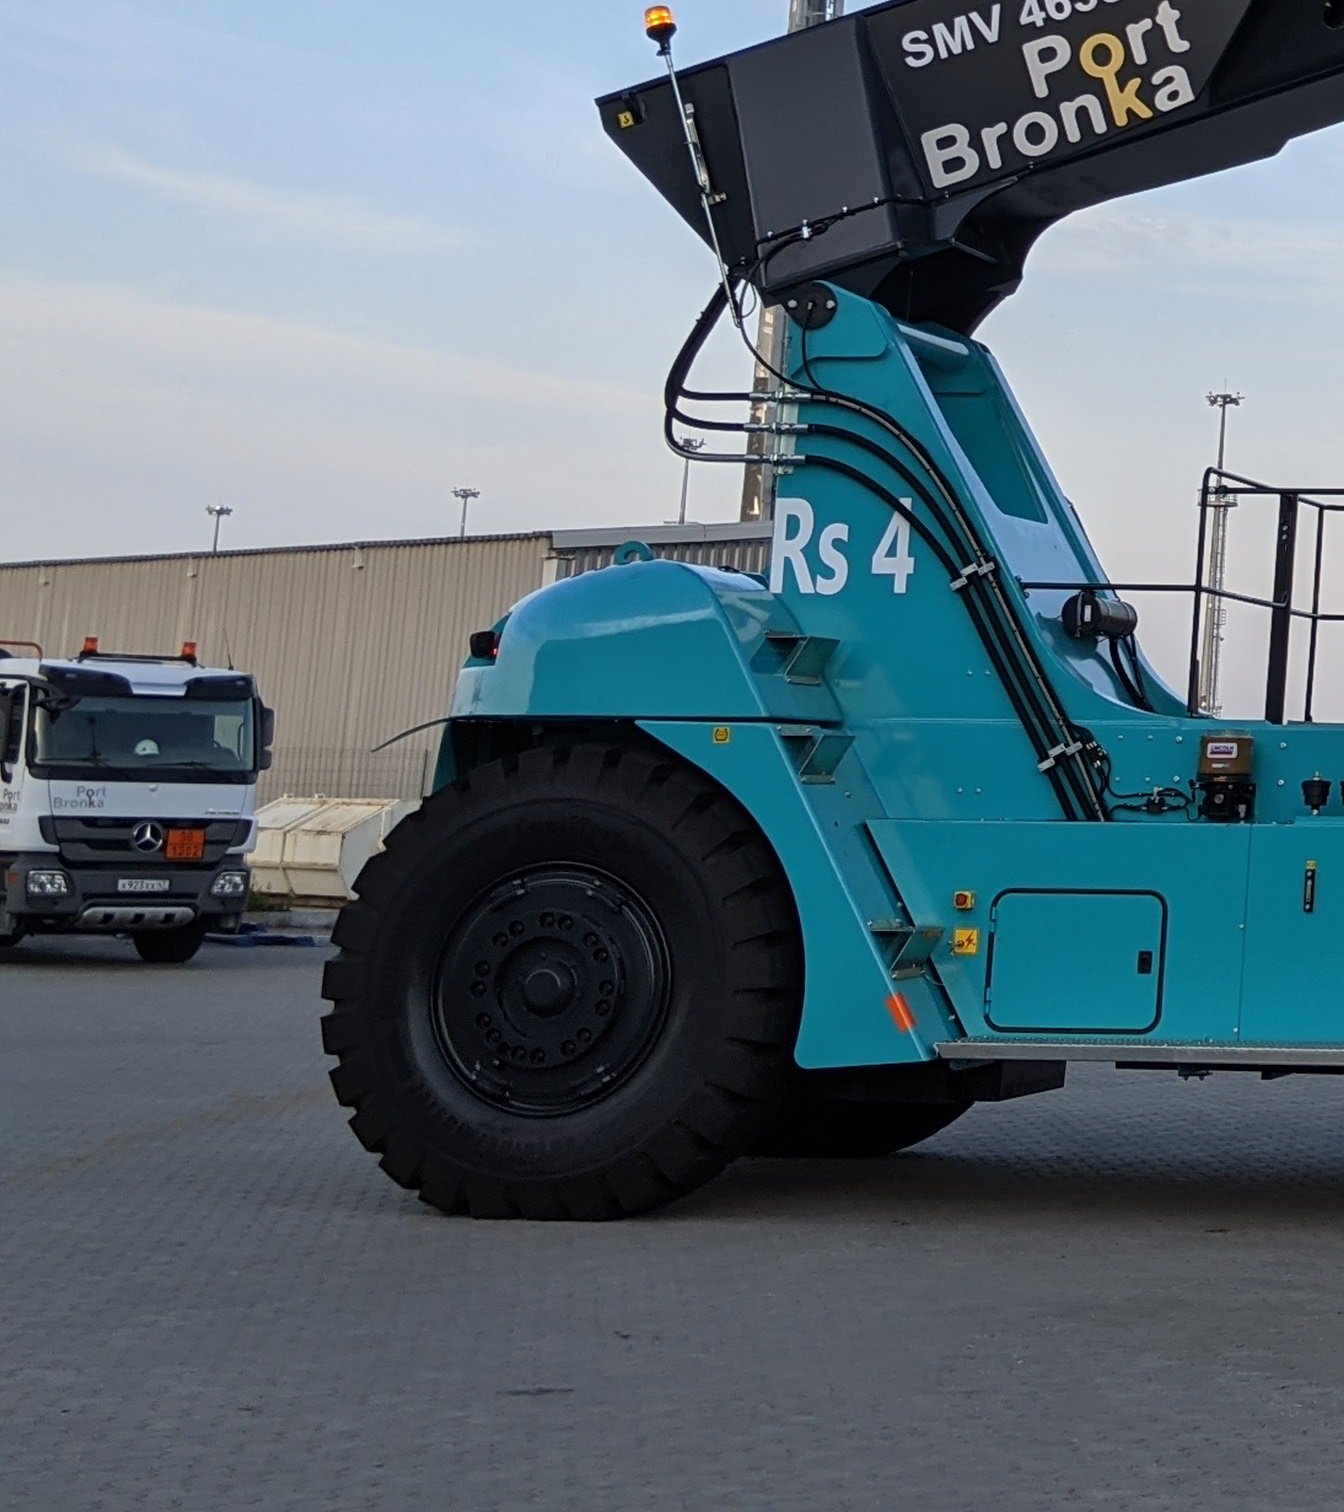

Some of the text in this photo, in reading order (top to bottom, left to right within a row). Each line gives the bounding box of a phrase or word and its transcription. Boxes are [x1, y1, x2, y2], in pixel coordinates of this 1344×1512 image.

[902, 3, 1001, 68] SMV
[1021, 0, 1191, 99] Port
[920, 64, 1196, 189] Bronka
[769, 497, 915, 595] Rs 4
[53, 796, 105, 809] Bronka
[77, 786, 106, 798] Port
